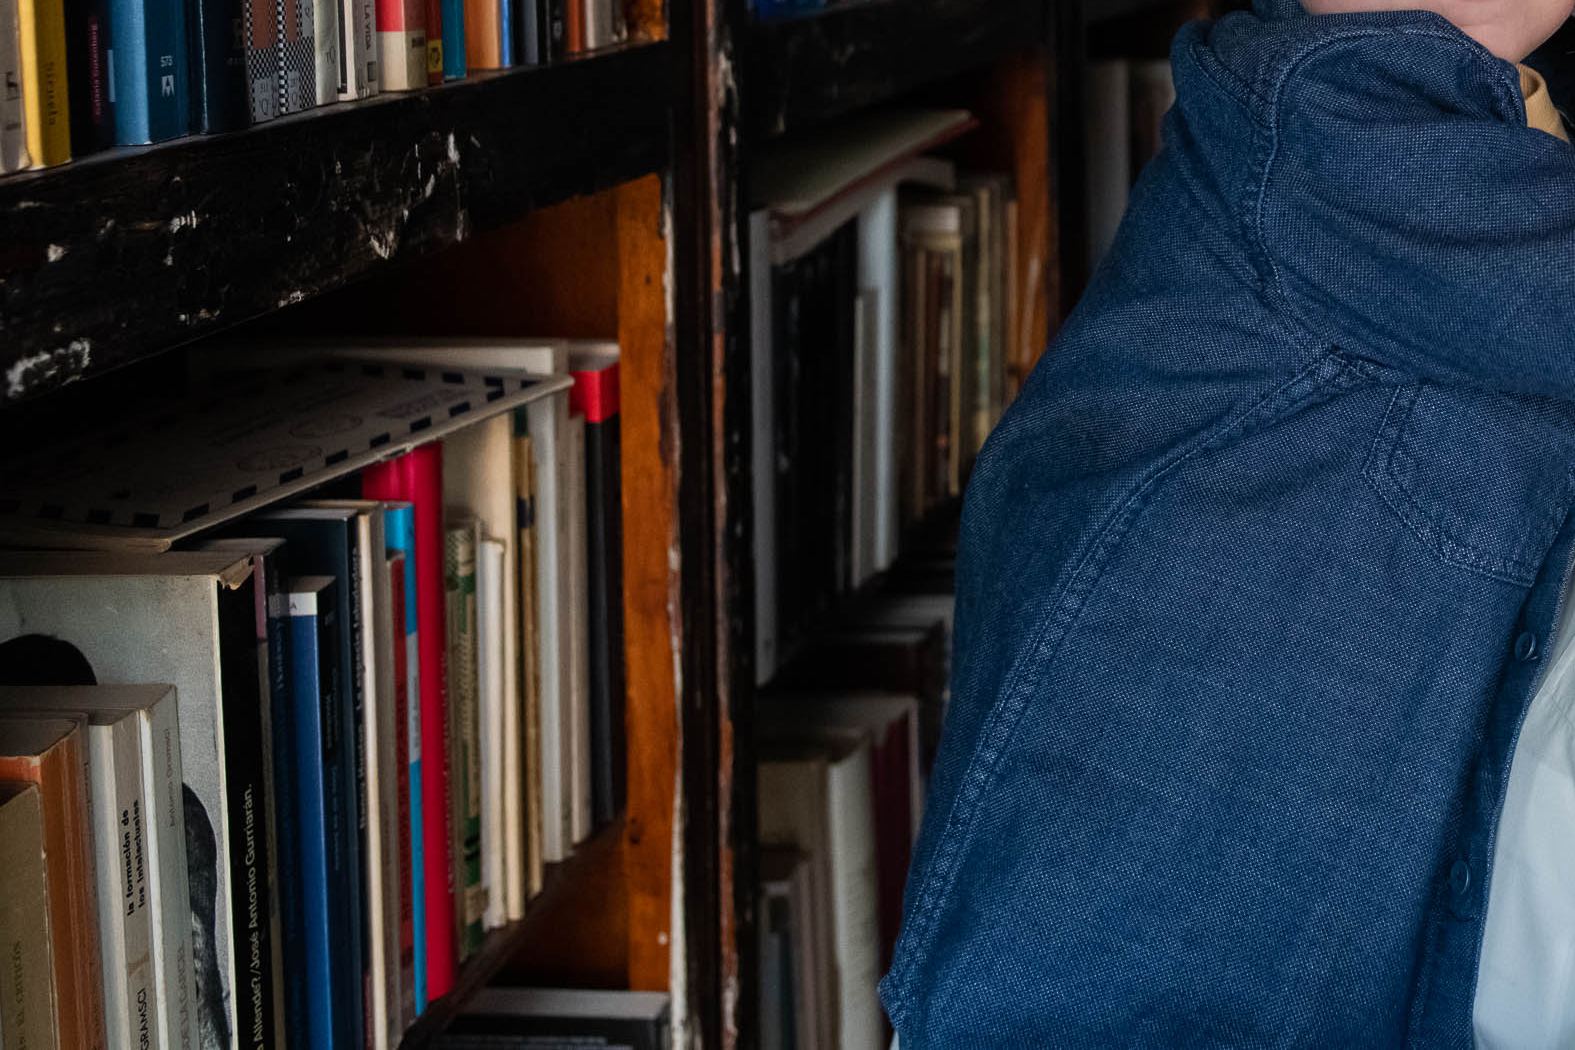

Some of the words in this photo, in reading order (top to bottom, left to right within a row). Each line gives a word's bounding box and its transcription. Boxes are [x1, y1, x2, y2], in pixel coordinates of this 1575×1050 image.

[364, 5, 371, 21] LA
[365, 23, 373, 50] VIDA
[120, 809, 130, 826] de
[237, 782, 257, 867] Gurriarán.
[133, 799, 146, 881] intelectuales
[123, 831, 134, 898] formación
[127, 902, 135, 916] la
[137, 885, 146, 908] los
[243, 866, 260, 929] Antonio
[136, 989, 150, 1050] GRAMSCI
